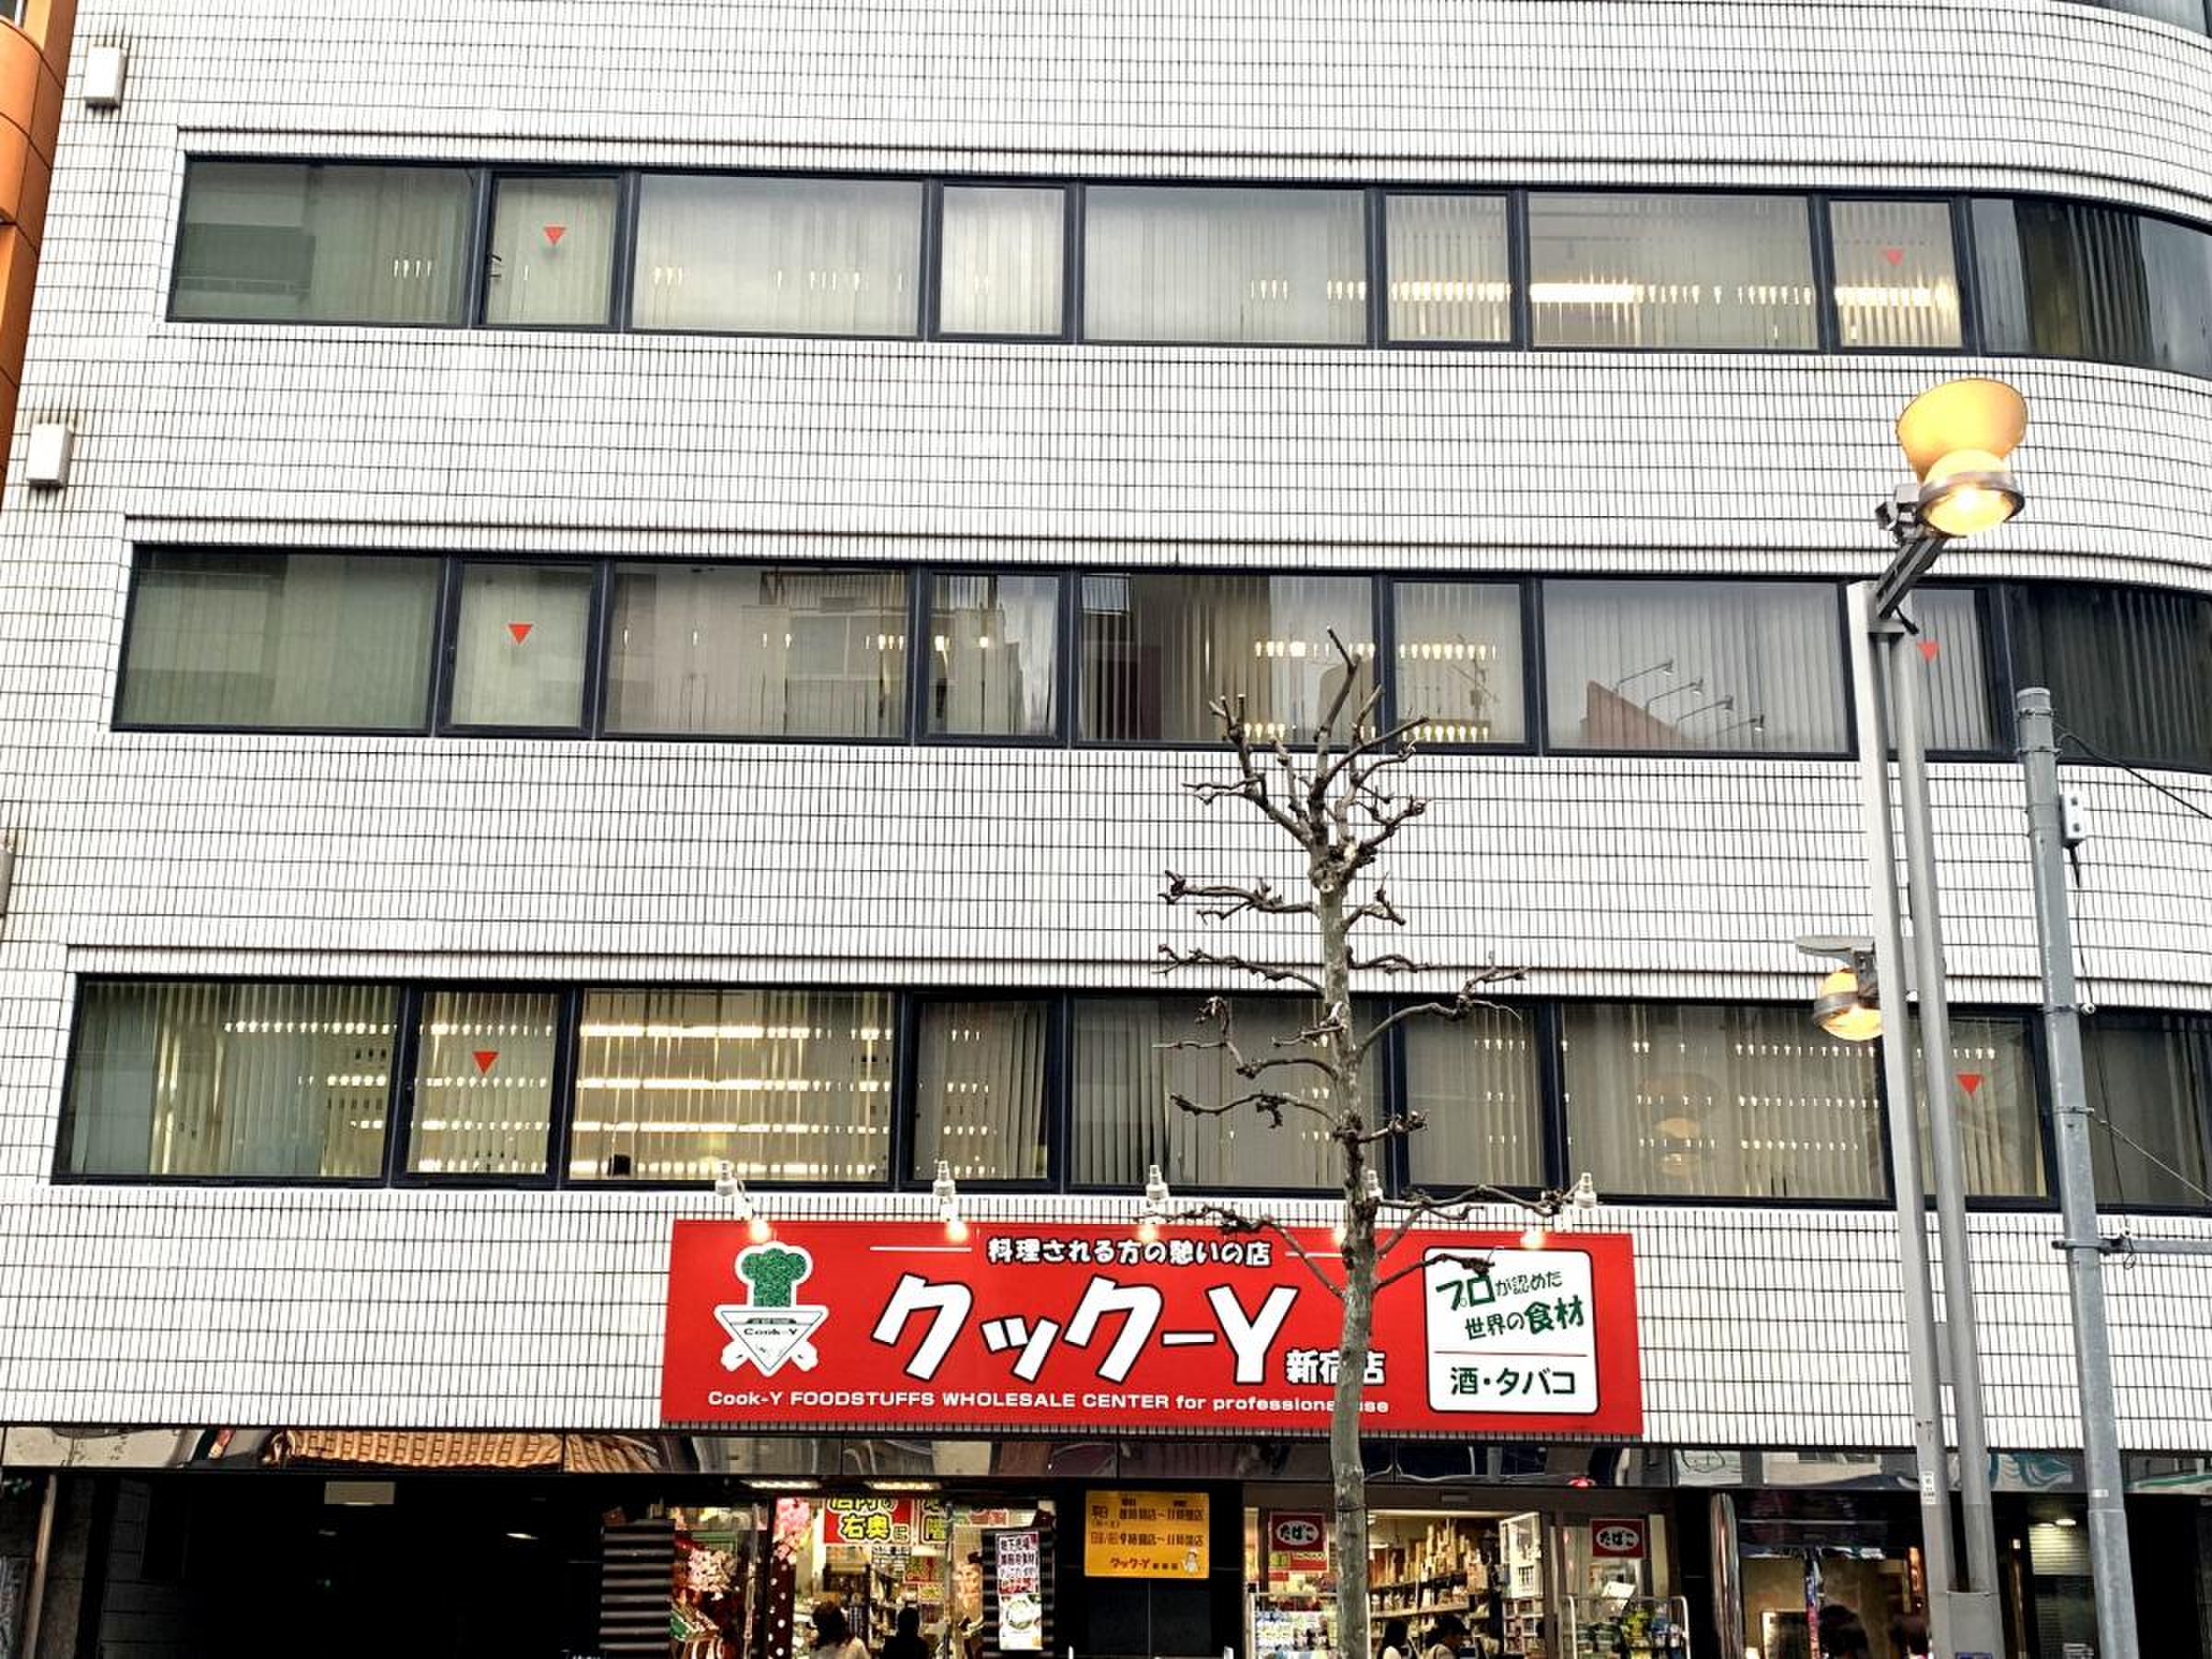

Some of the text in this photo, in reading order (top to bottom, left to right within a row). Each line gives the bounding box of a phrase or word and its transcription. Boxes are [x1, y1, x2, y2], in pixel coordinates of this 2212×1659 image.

[988, 1239, 1271, 1265] 料理される方の憩いの店
[1436, 1271, 1562, 1311] プロが認めた
[1465, 1295, 1583, 1340] 世界の食材
[1451, 1367, 1575, 1395] 酒・タバコ
[708, 1391, 782, 1406] Cook-Y
[790, 1392, 935, 1406] FOODSTUFFS
[943, 1393, 1076, 1408] WHOLESALE
[1082, 1394, 1170, 1409] CENTER
[1176, 1395, 1205, 1410] for
[1213, 1396, 1335, 1414] professiona
[1280, 1524, 1314, 1541] たばこ
[1600, 1530, 1635, 1547] たばこ
